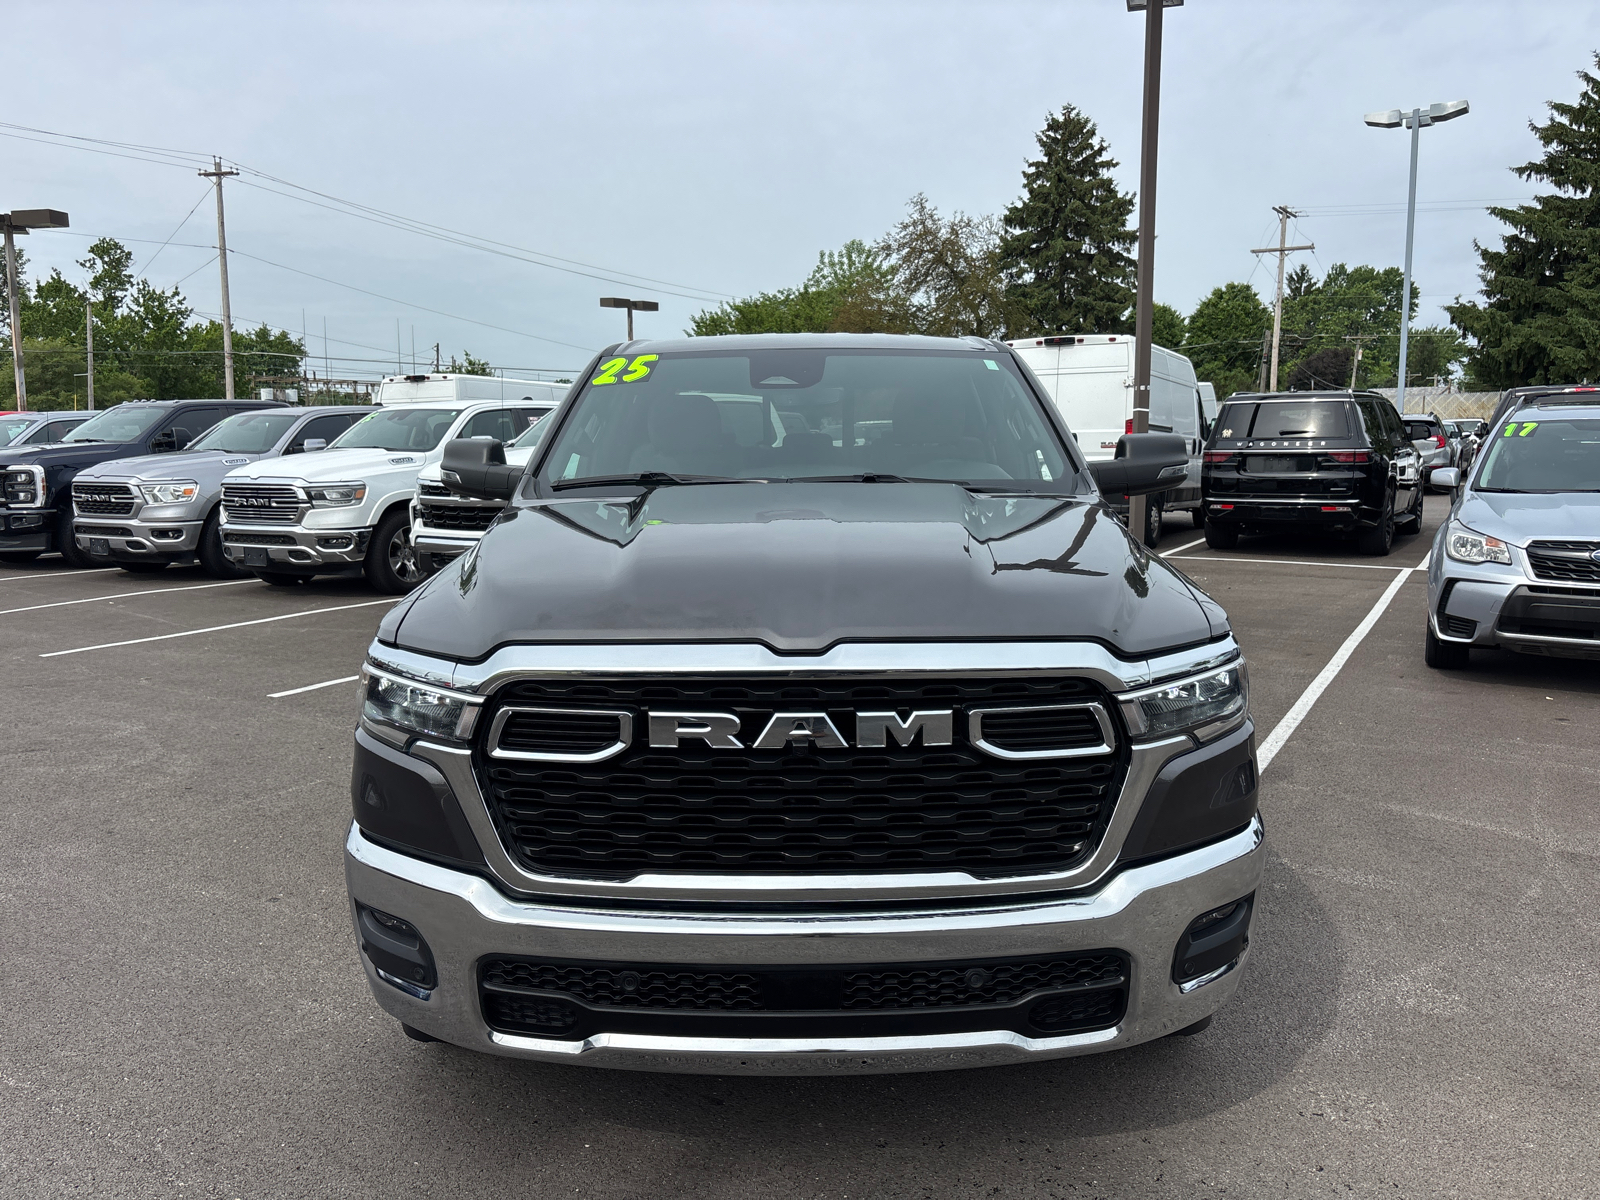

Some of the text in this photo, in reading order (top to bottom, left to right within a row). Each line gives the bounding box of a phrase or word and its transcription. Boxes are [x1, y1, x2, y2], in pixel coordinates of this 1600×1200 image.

[592, 354, 659, 385] 25
[1503, 422, 1539, 437] 17
[83, 494, 109, 502] RAM
[238, 498, 269, 506] RAM
[648, 709, 955, 749] RAM
